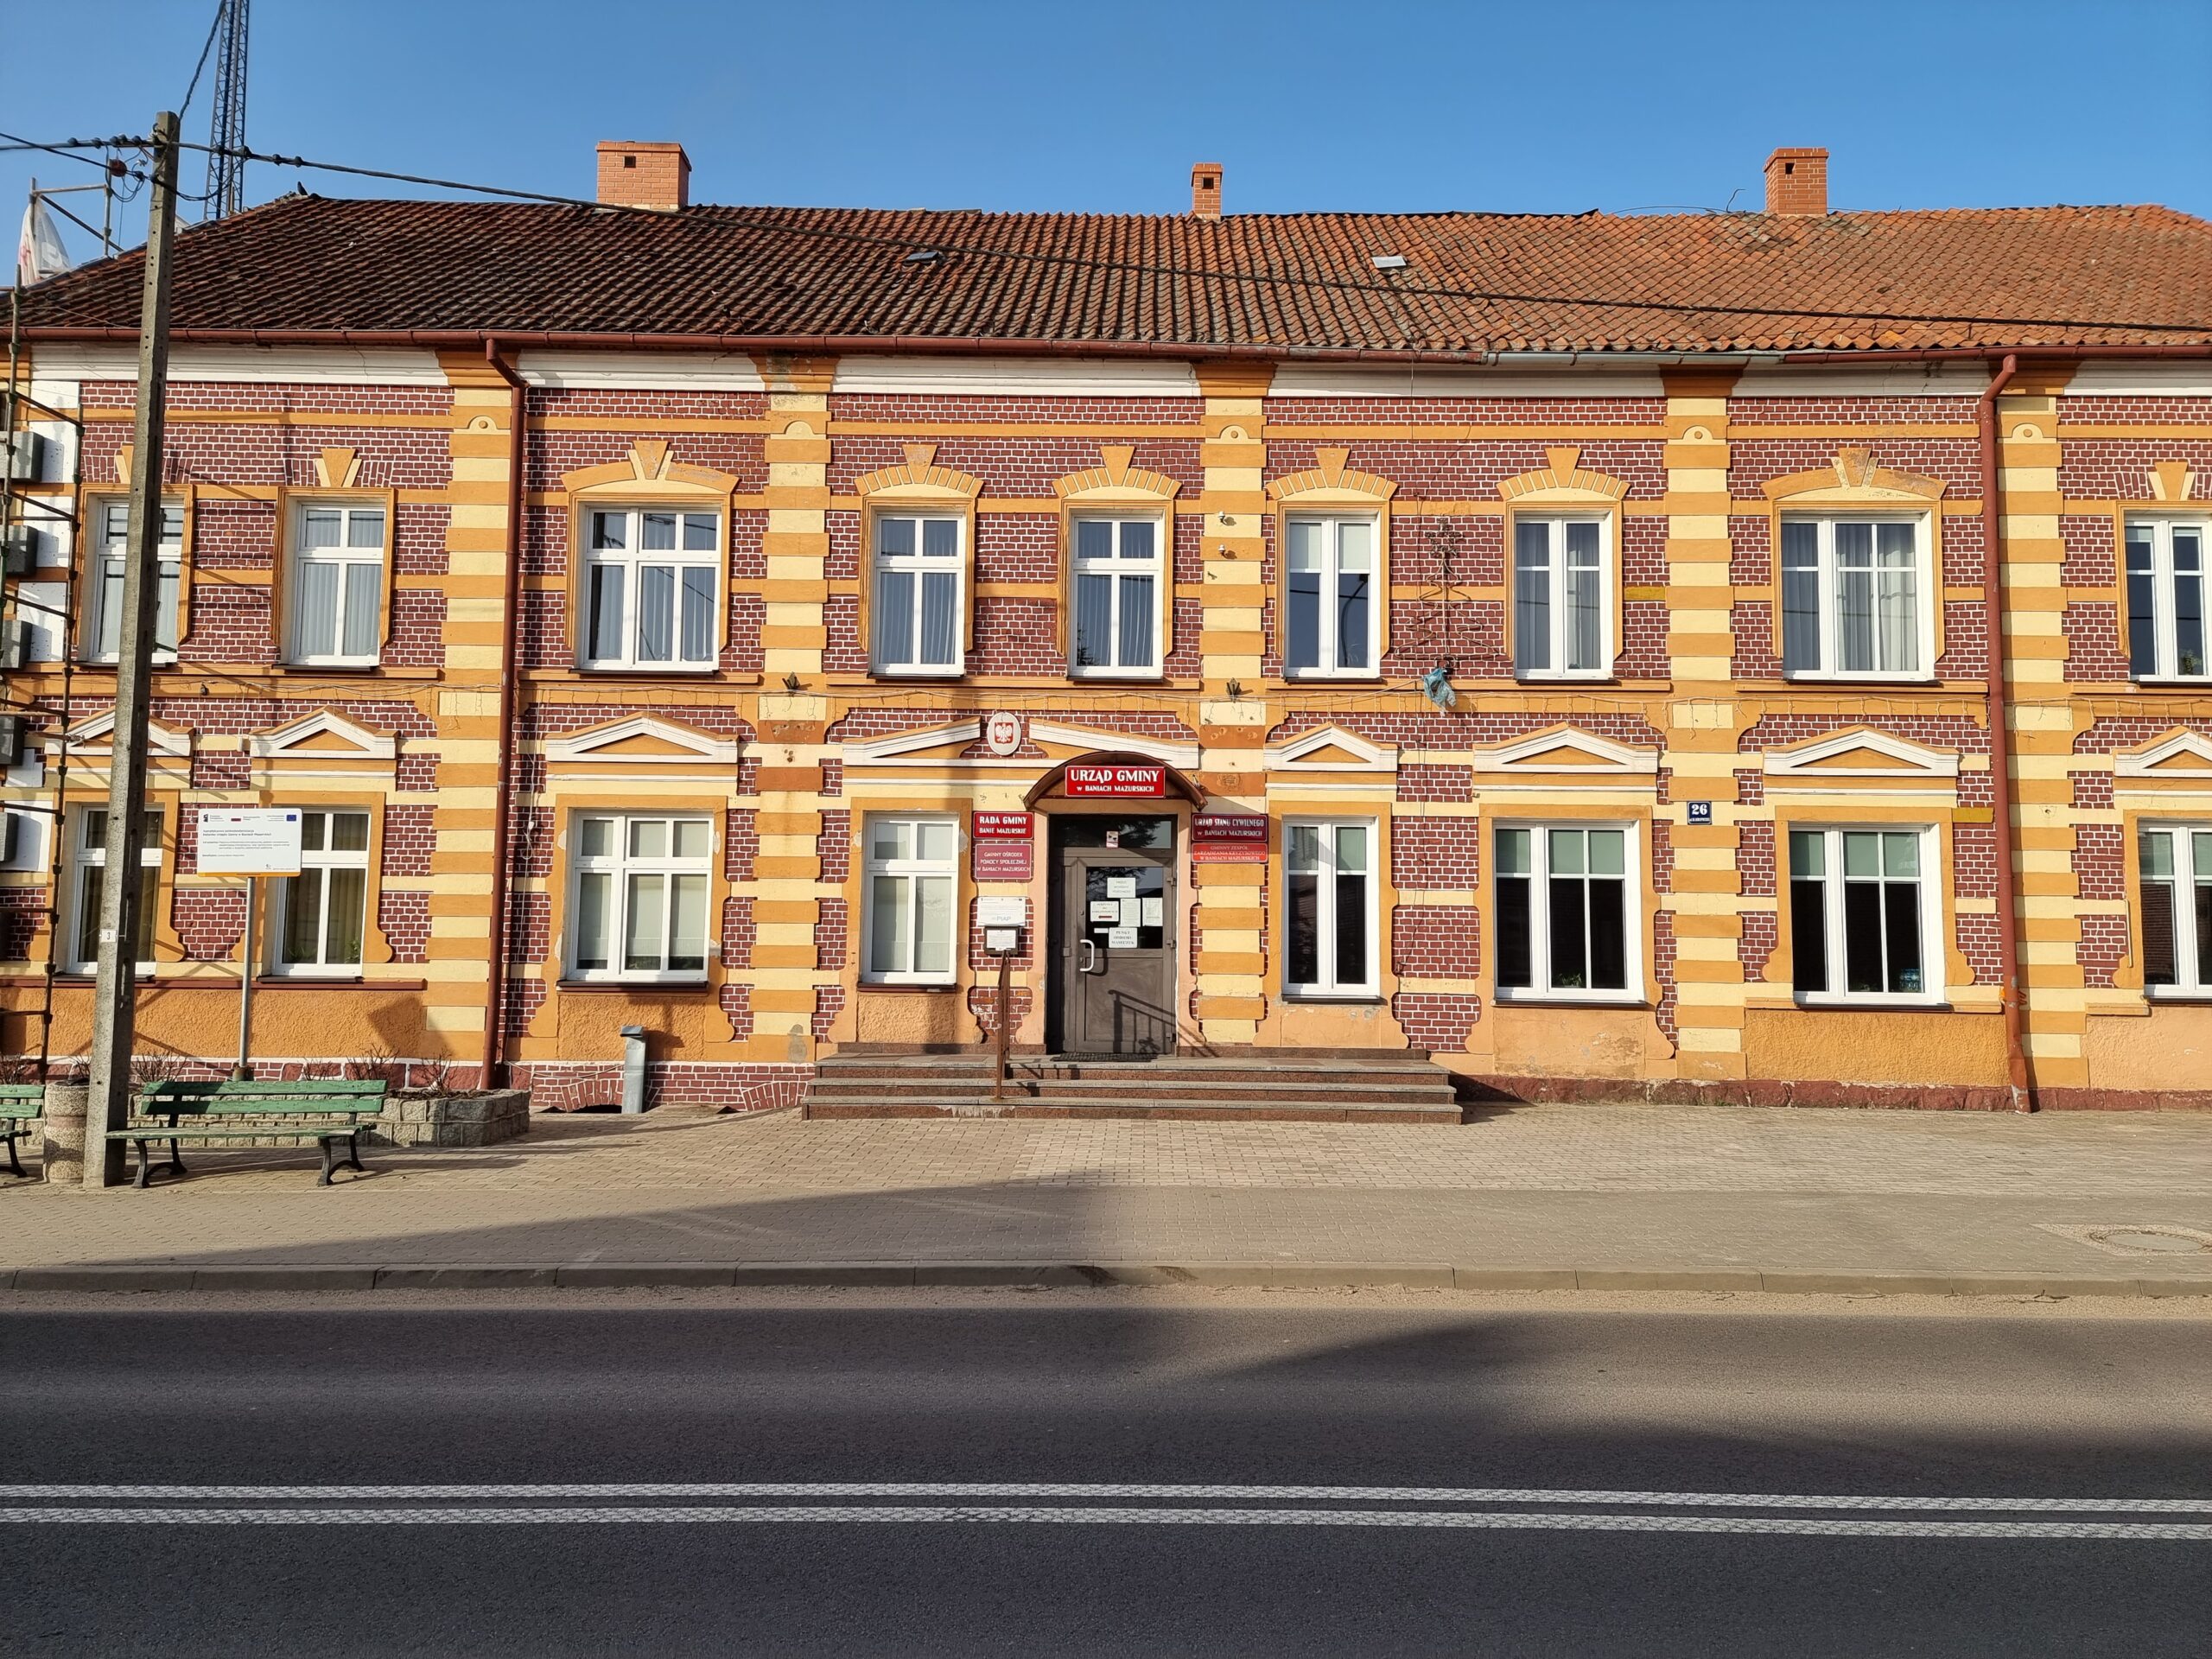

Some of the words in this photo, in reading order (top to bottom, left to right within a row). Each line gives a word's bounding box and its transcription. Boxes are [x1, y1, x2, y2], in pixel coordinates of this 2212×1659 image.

[1071, 769, 1113, 784] URZĄD
[1116, 770, 1160, 782] GMINY
[1691, 804, 1708, 816] 26
[979, 816, 1001, 824] RADA
[1002, 816, 1027, 825] GMINY
[1194, 818, 1213, 828] URZĄD
[1214, 818, 1231, 827] STANU
[1232, 818, 1264, 827] CYWILNEGO
[106, 931, 111, 940] 3
